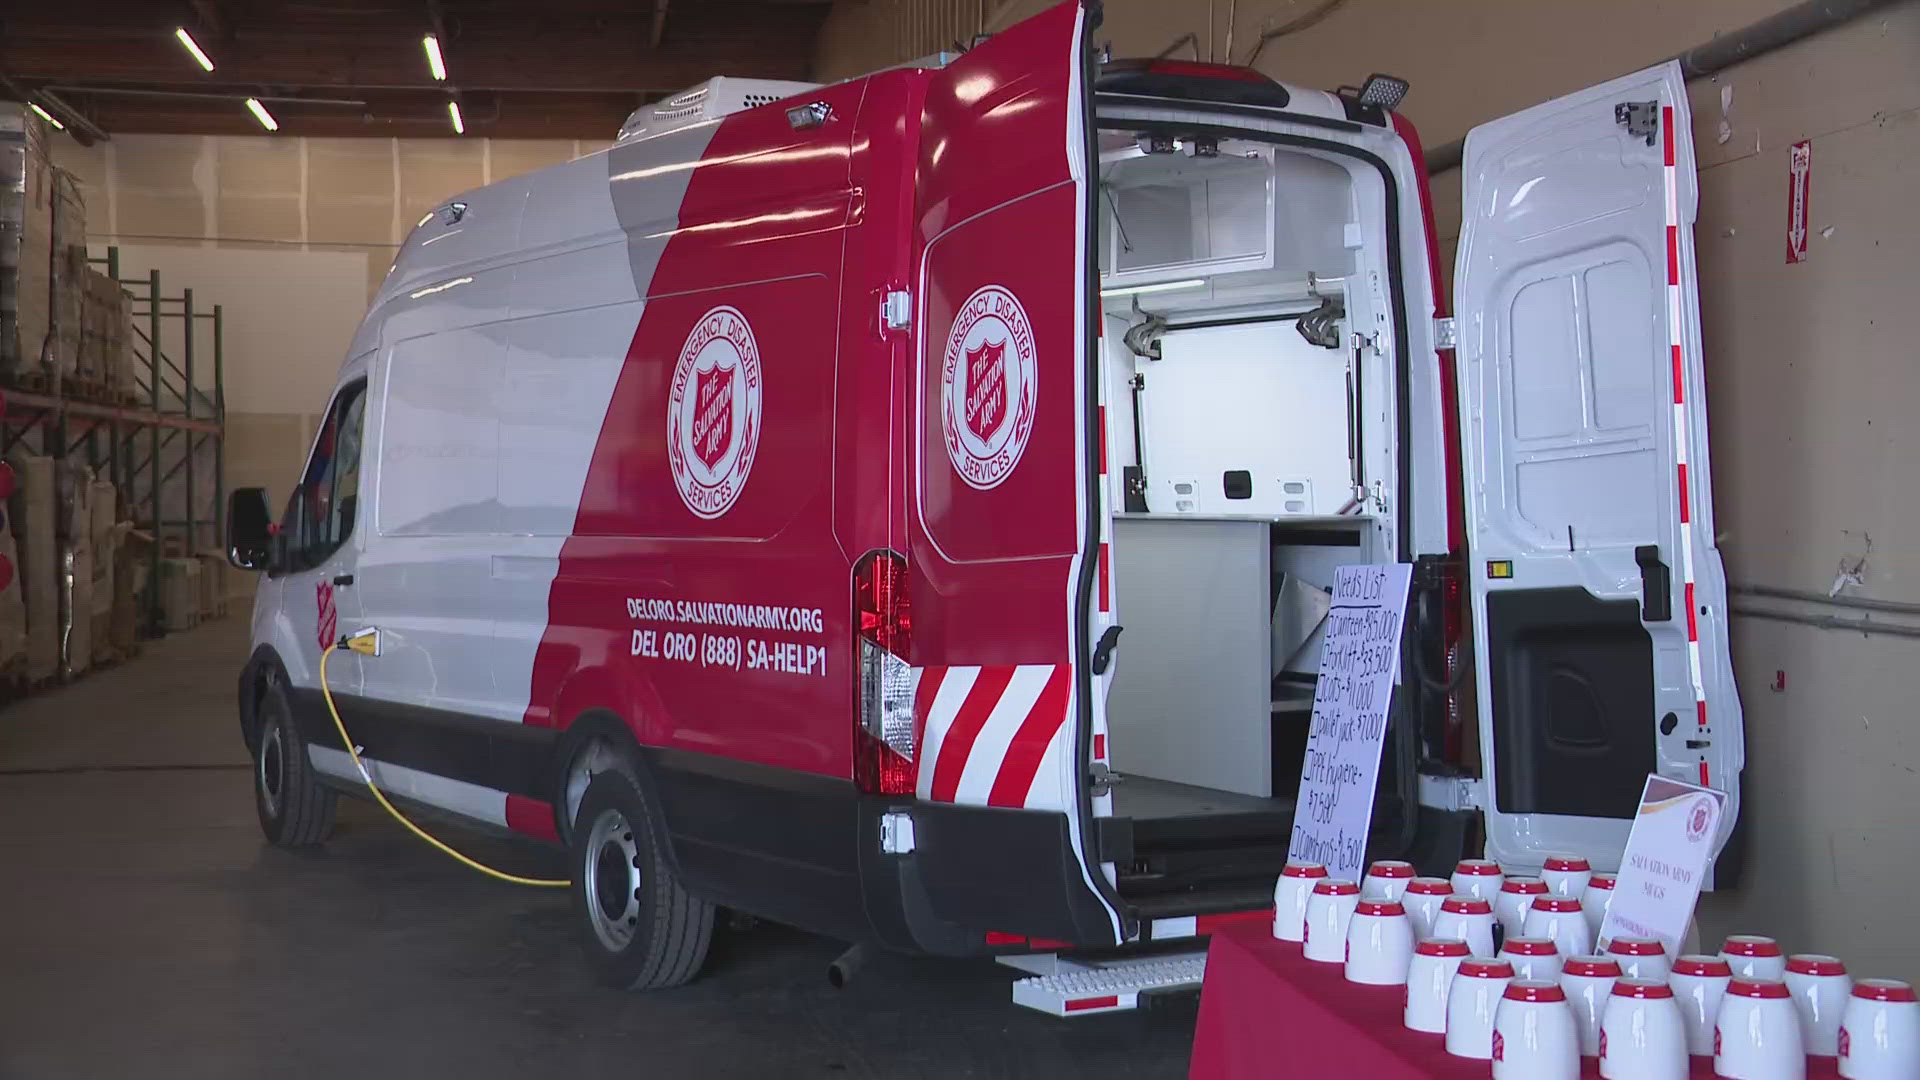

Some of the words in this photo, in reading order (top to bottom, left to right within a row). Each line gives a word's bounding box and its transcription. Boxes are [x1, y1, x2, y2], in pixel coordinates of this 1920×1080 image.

[673, 316, 723, 403] EMERGENCY
[727, 319, 757, 391] DISASTER
[946, 295, 990, 384] EMERGENCY
[994, 296, 1030, 361] DISASTER
[701, 371, 719, 407] THE
[967, 350, 1004, 422] SALVATION
[971, 348, 989, 385] THE
[693, 375, 733, 446] SALVATION
[979, 381, 1003, 435] ARMY
[704, 408, 729, 460] ARMY
[963, 449, 1010, 481] SERVICES
[687, 480, 732, 510] SERVICES
[1333, 567, 1362, 600] Needs
[627, 598, 823, 633] DELORO.SALVATIONARMY.ORG
[631, 629, 659, 658] DEL
[663, 631, 697, 662] ORO
[701, 633, 742, 672] (888)
[746, 639, 827, 677] SA-HELP1
